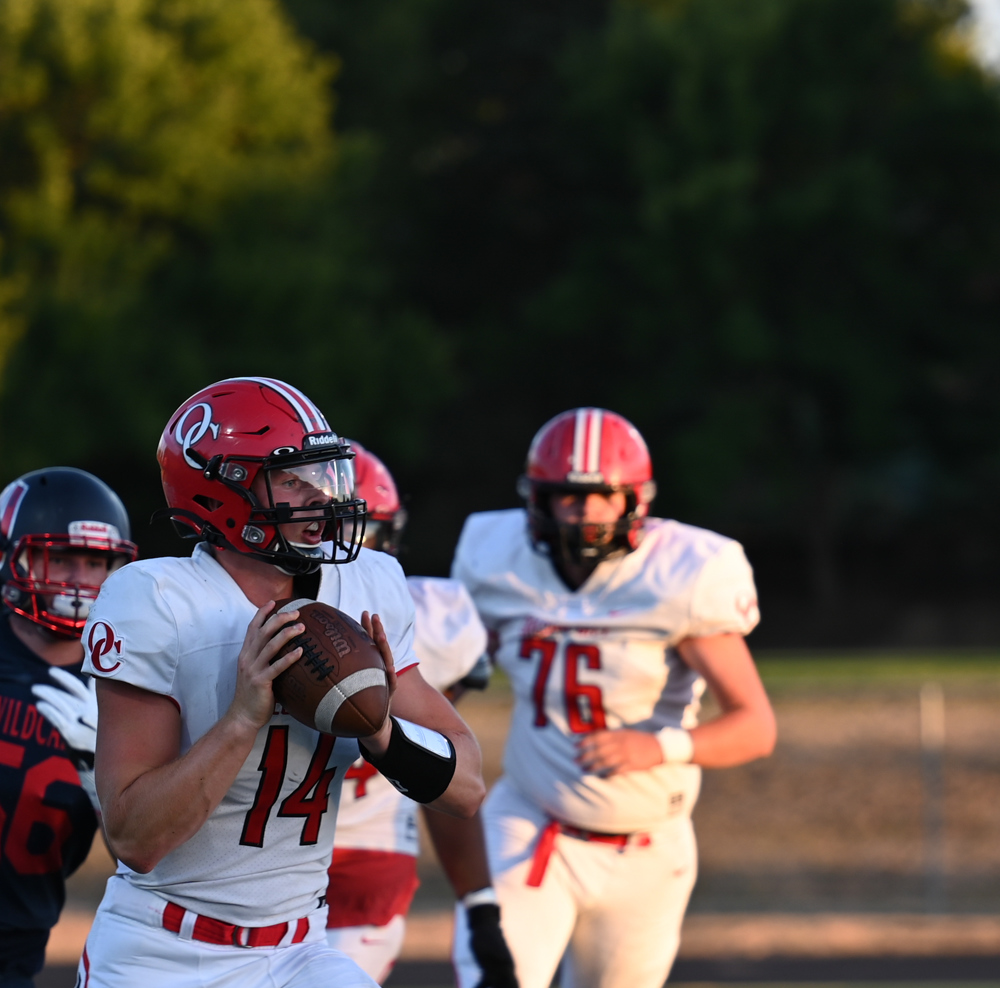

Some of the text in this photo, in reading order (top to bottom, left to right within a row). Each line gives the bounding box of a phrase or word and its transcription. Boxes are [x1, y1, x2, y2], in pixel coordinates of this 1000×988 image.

[88, 621, 121, 673] OC
[518, 637, 607, 735] 76
[239, 725, 338, 848] 14
